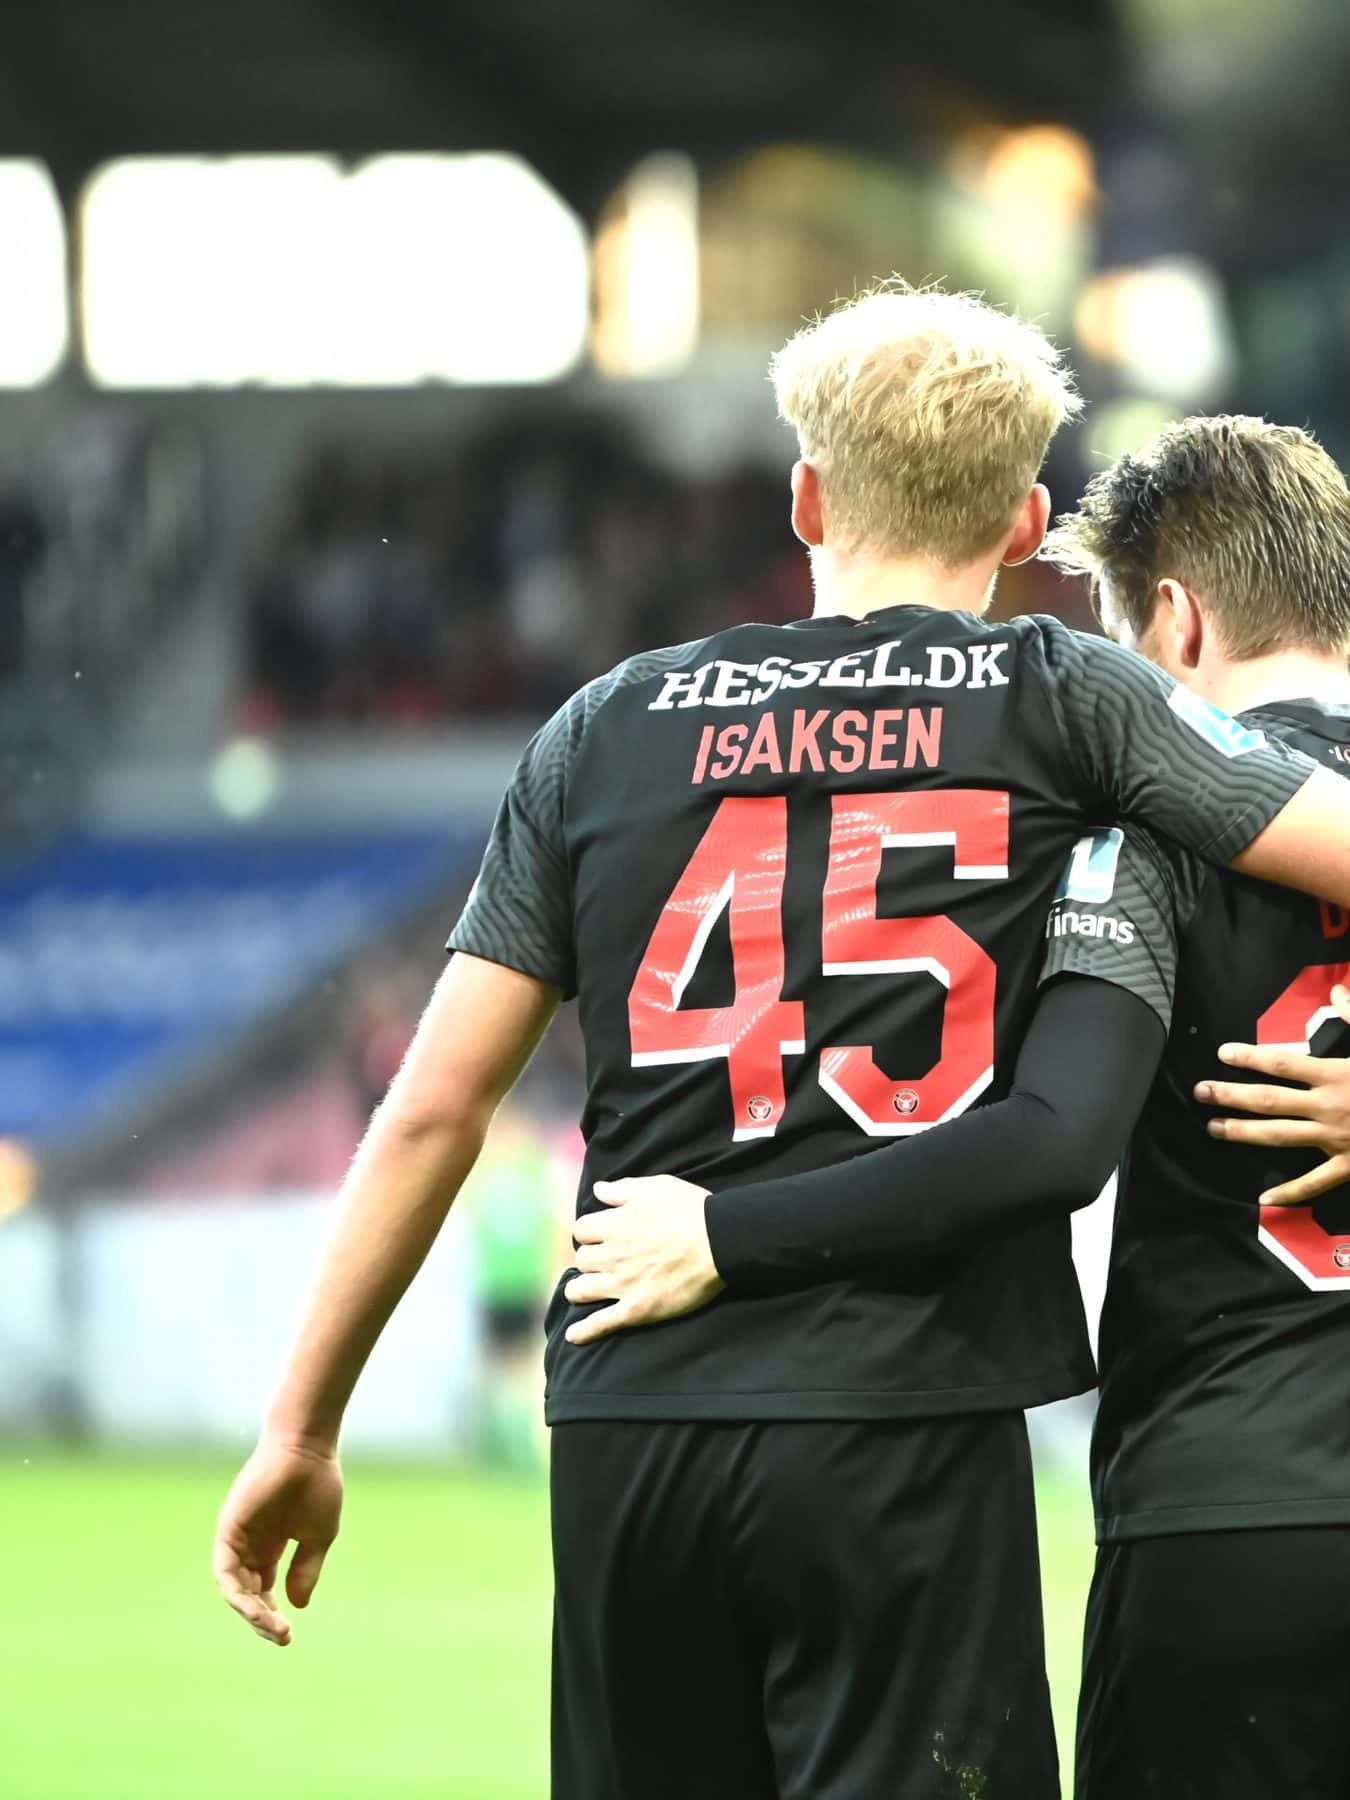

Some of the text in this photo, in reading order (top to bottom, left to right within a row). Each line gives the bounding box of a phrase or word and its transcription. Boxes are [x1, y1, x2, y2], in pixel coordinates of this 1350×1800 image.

[648, 640, 1010, 711] HESSEL.DK
[691, 706, 944, 785] ISAKSEN
[627, 788, 1009, 1142] 45
